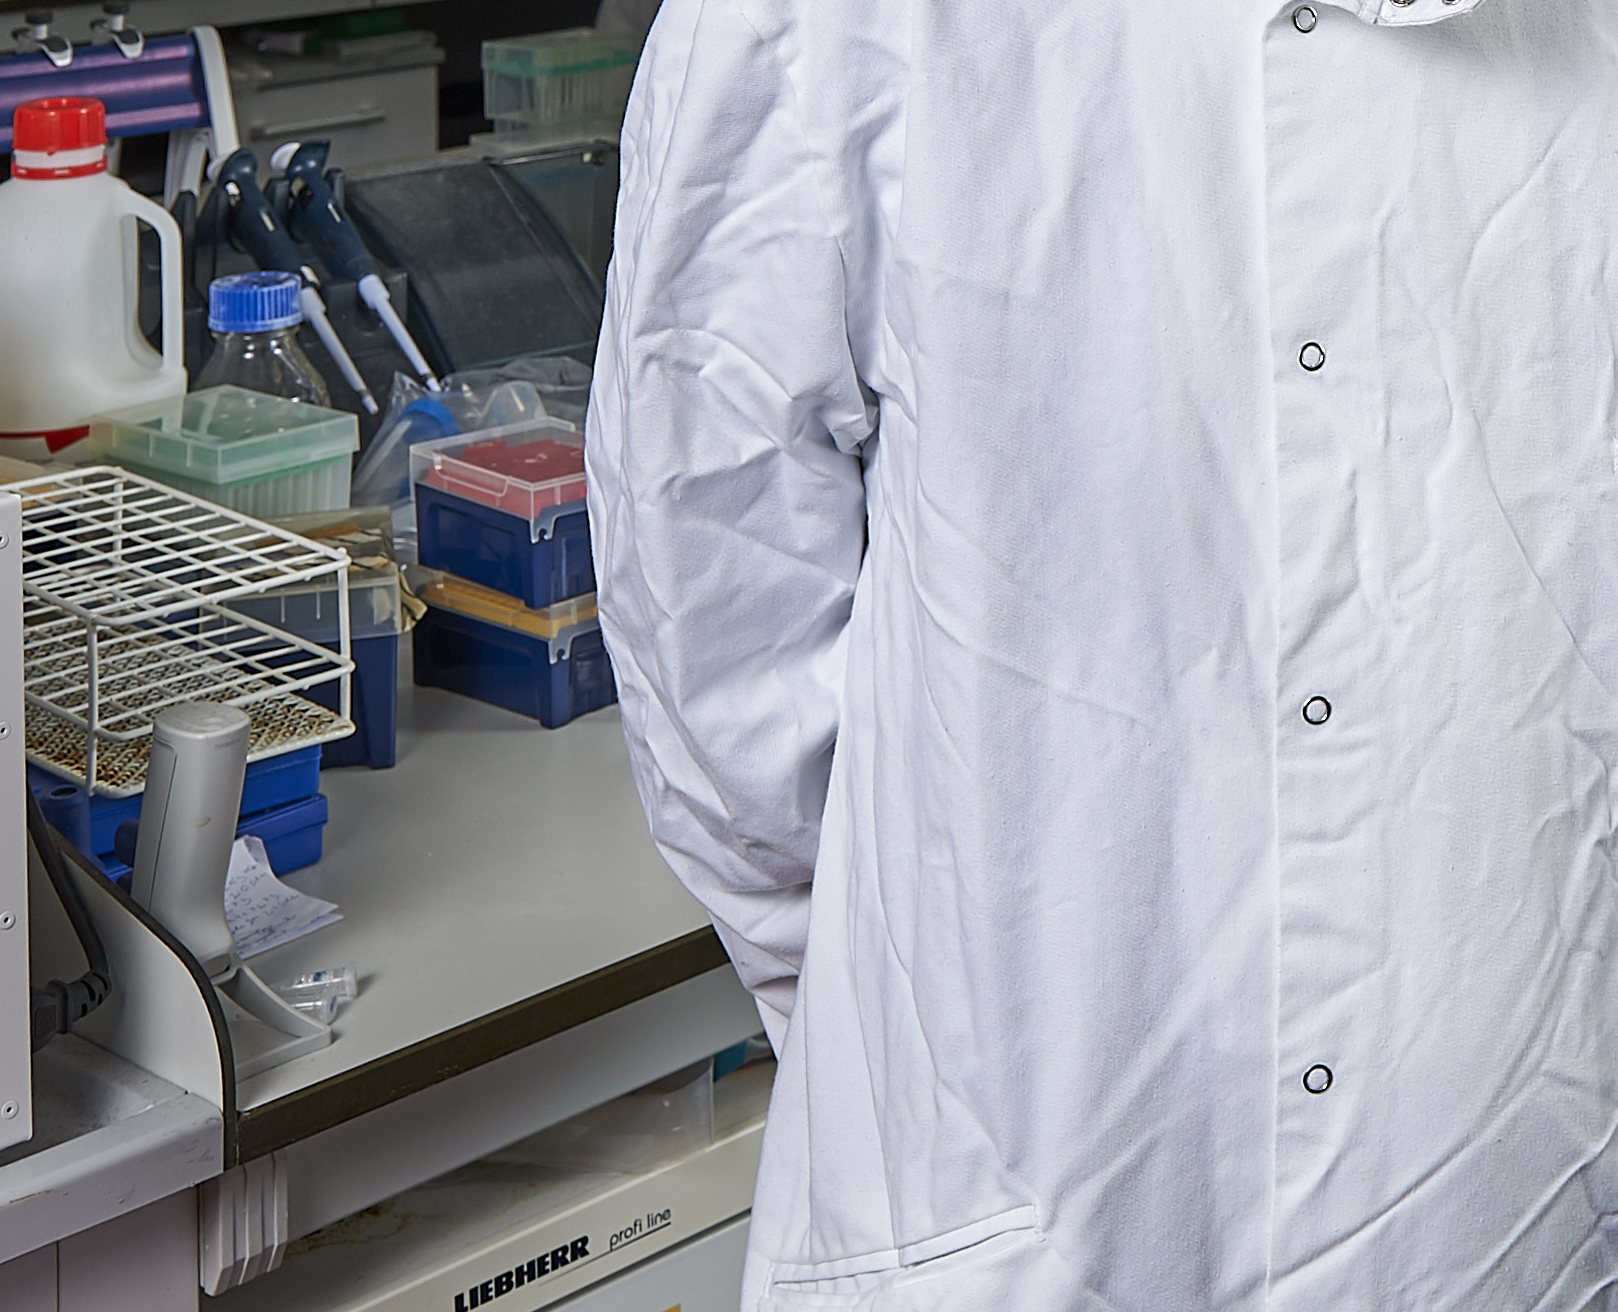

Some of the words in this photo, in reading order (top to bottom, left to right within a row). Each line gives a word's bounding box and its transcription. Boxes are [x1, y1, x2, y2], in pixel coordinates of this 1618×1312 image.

[453, 1235, 590, 1312] LIEBHERR
[609, 1218, 642, 1251] profi
[647, 1208, 672, 1229] line
